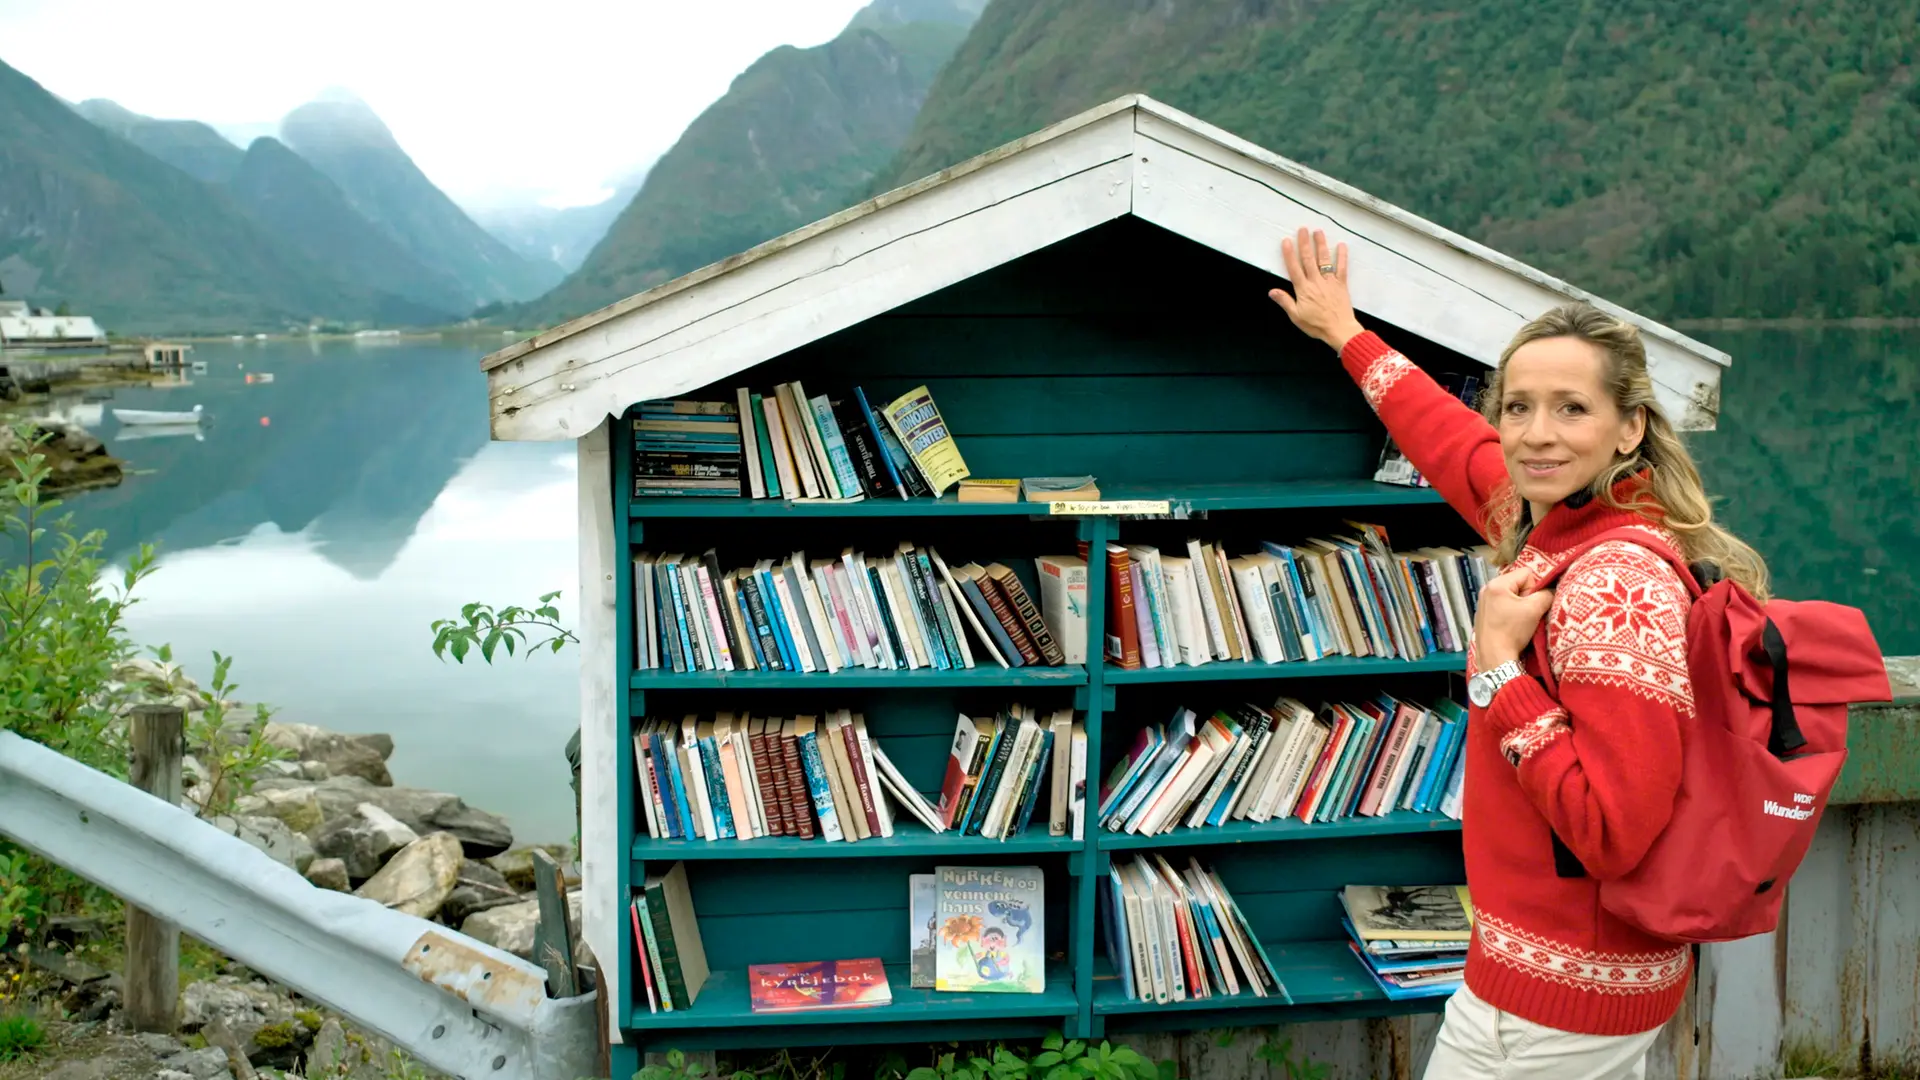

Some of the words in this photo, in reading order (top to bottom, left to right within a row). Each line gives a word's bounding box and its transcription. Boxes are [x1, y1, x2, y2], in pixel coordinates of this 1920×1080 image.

[860, 783, 874, 814] HARMONY
[1793, 792, 1813, 805] WDR
[943, 869, 1015, 889] NURKEN
[1017, 878, 1038, 891] og
[943, 889, 1013, 901] vennene
[941, 901, 983, 914] hans
